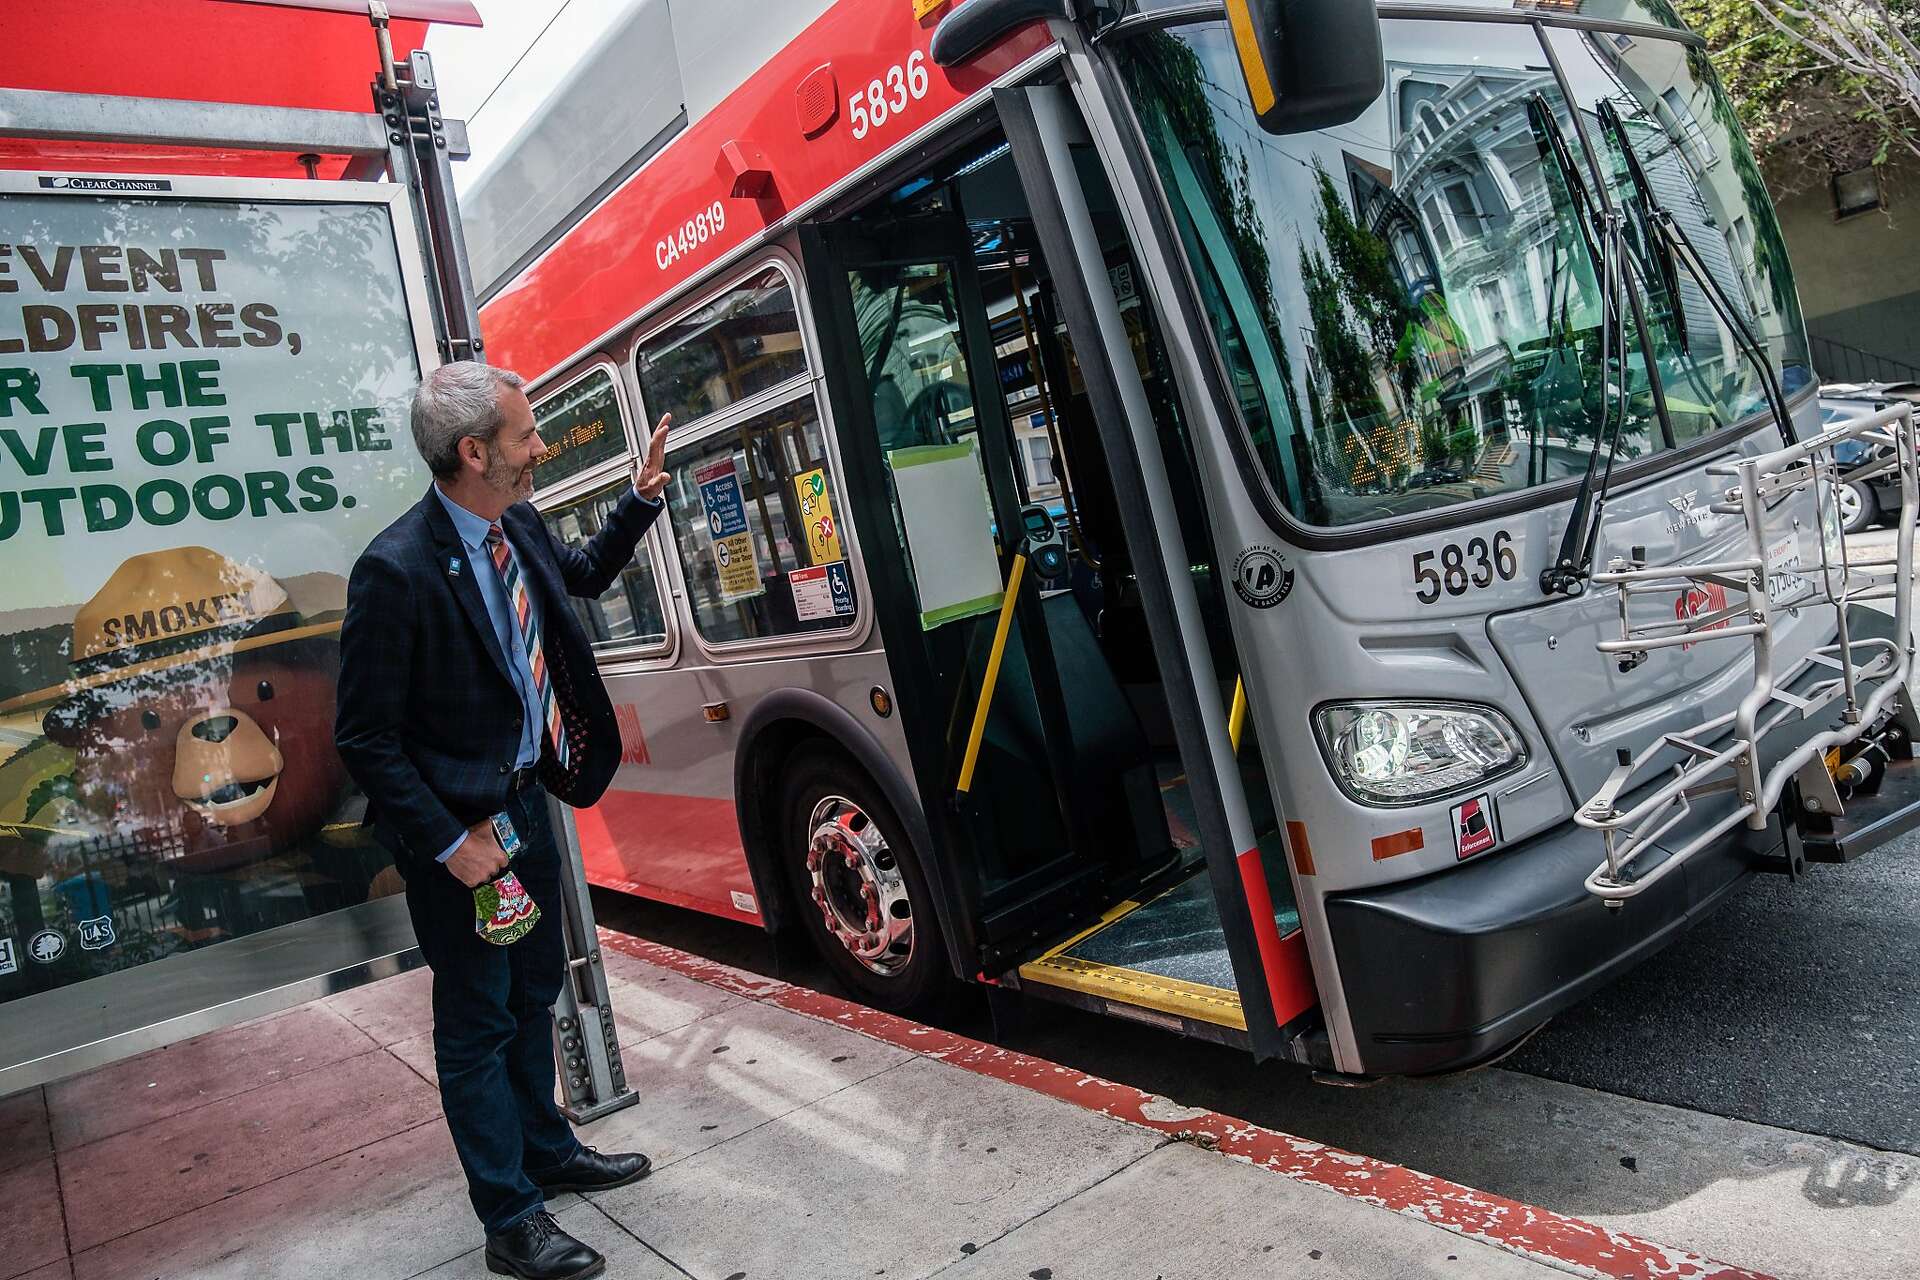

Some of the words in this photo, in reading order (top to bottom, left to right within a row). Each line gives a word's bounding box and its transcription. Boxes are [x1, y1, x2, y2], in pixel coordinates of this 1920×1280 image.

[848, 49, 929, 140] 5836
[655, 200, 725, 270] CA49819
[70, 359, 228, 412] THE
[136, 415, 232, 466] OF
[254, 407, 393, 457] THE
[715, 481, 733, 493] Access
[716, 492, 731, 504] Only
[1412, 530, 1517, 605] 5836
[102, 591, 256, 648] SMOKEY
[1460, 835, 1491, 852] Enforcement
